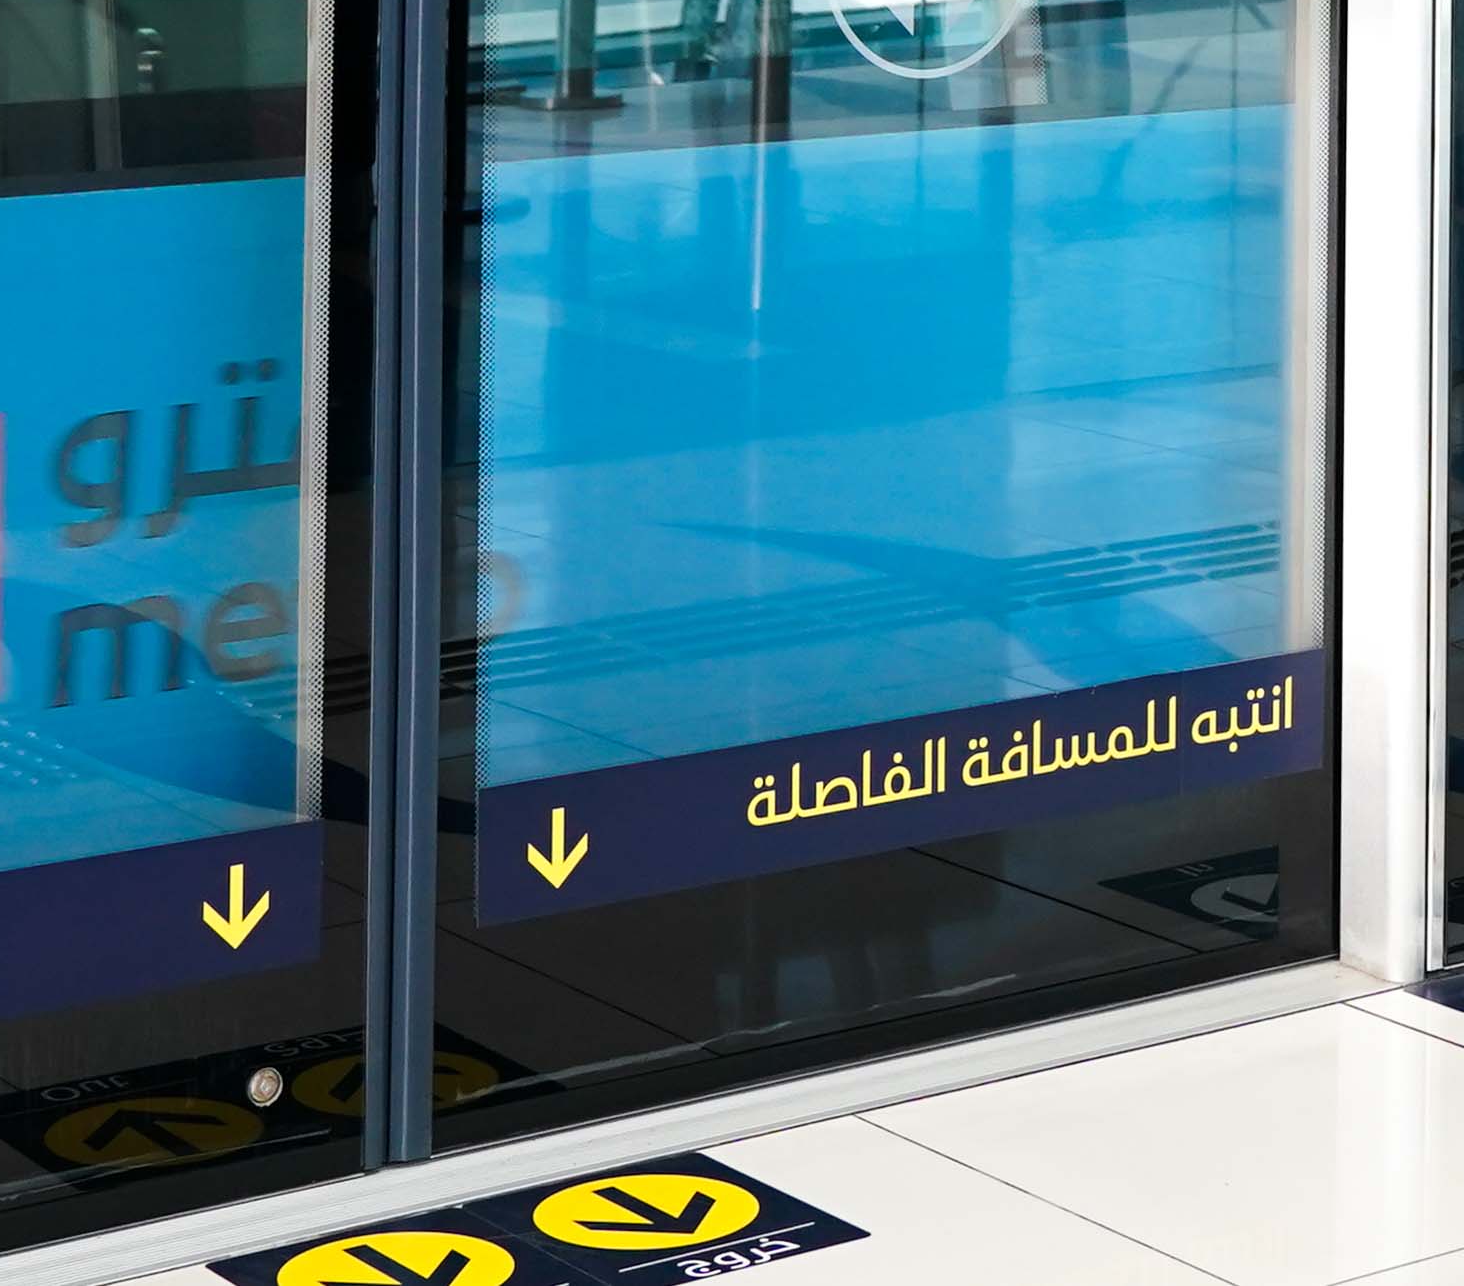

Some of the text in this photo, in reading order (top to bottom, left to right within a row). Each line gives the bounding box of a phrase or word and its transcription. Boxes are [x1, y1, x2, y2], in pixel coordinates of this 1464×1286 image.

[745, 675, 1295, 828] انتبه للمسافة الفاصلة
[677, 1237, 800, 1278] خروج
